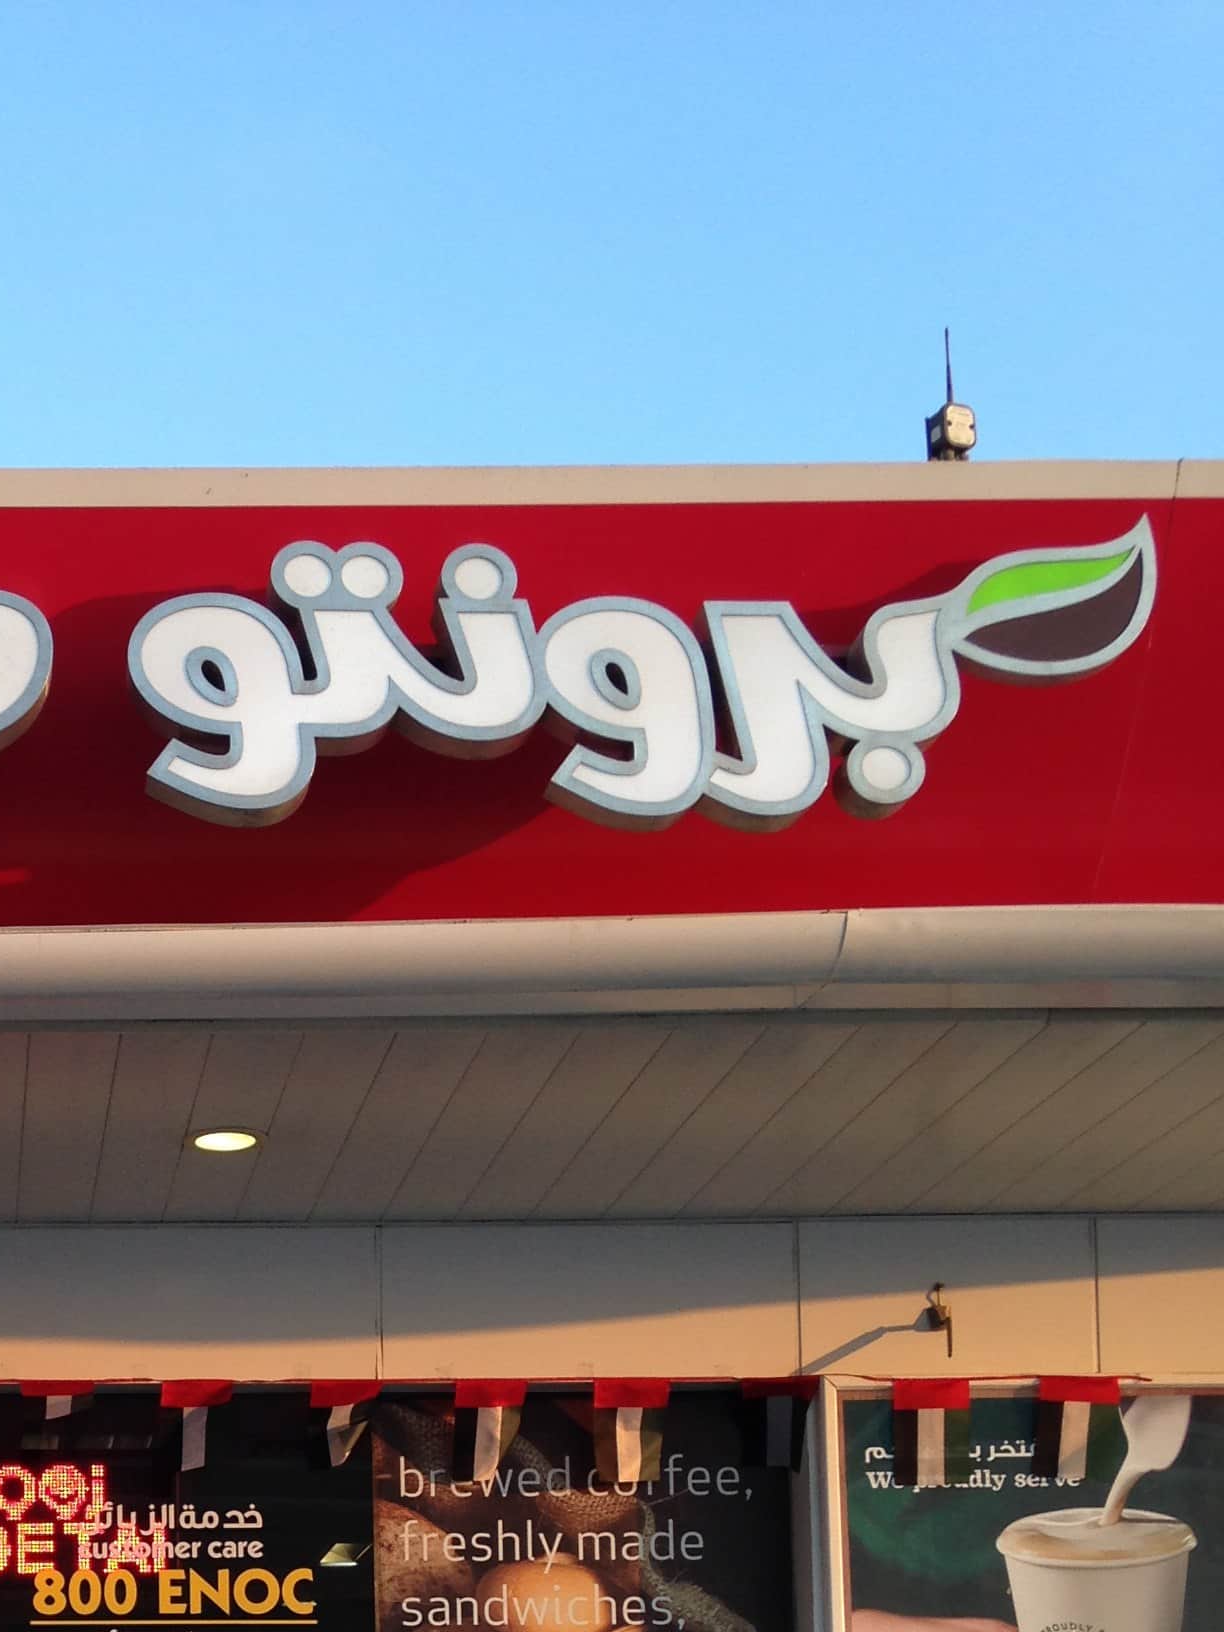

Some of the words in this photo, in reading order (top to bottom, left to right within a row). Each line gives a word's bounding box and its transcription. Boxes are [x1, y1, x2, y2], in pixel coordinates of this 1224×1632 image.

[127, 540, 963, 830] برونتو
[180, 1503, 263, 1529] خدمة
[79, 1540, 200, 1560] customer
[208, 1541, 263, 1559] care
[401, 1518, 563, 1573] freshly
[577, 1517, 704, 1561] made
[33, 1568, 137, 1615] 800
[159, 1568, 314, 1615] ENOC
[401, 1584, 686, 1629] sandwiches,
